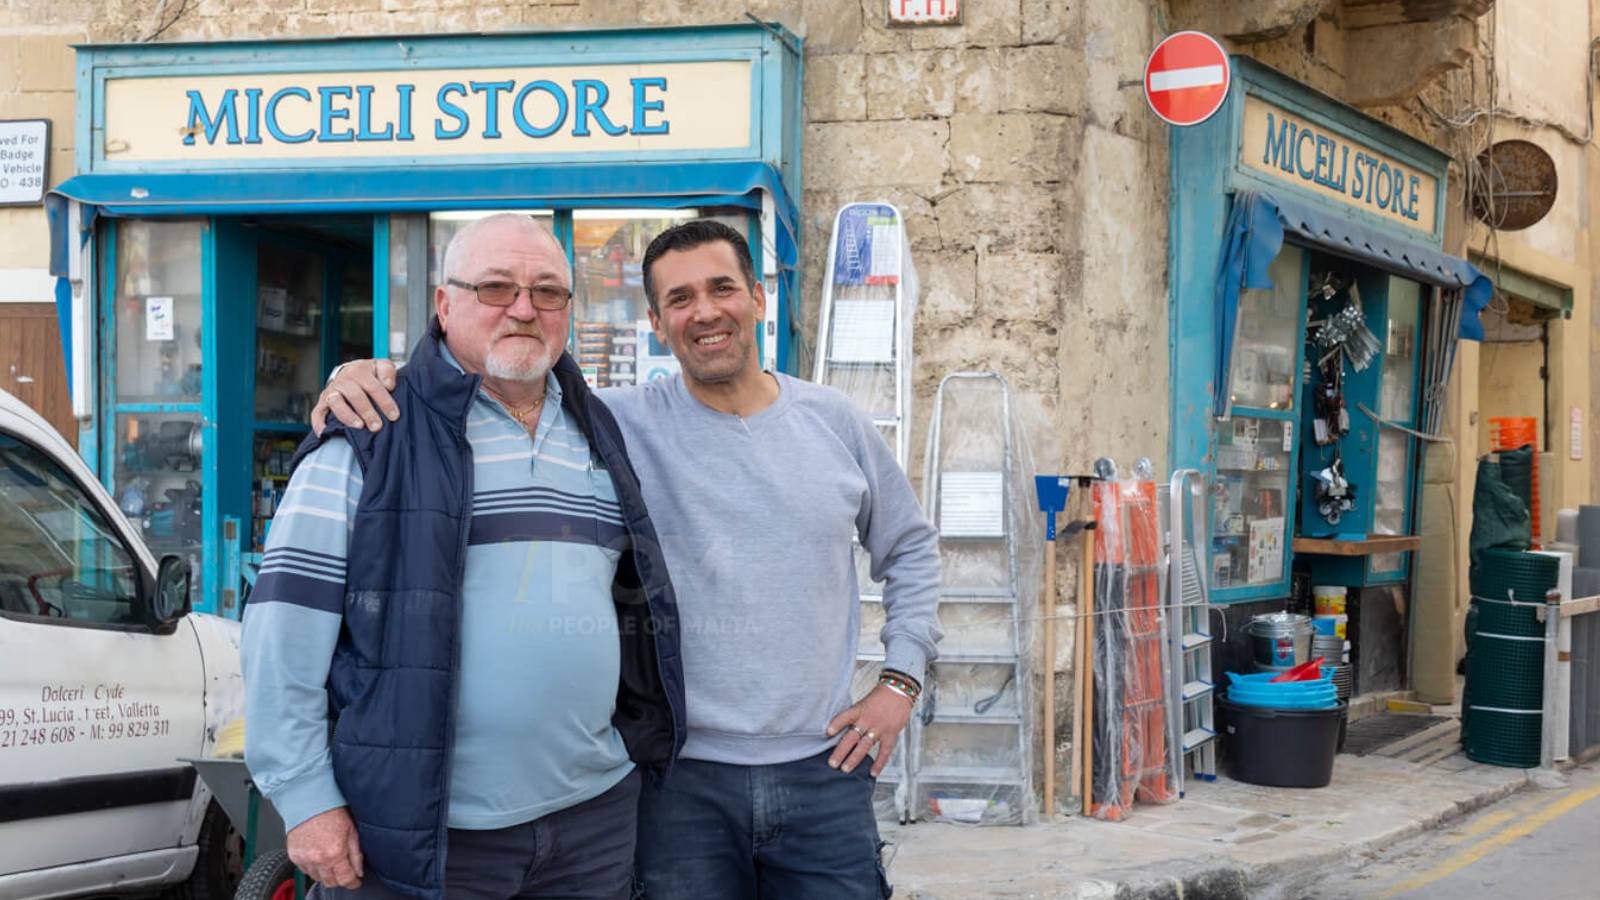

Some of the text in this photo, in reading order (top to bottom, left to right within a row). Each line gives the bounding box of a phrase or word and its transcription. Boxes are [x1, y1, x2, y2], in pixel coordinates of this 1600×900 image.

[183, 77, 670, 146] MICELI STORE
[21, 134, 39, 146] For
[0, 149, 34, 161] Badge
[3, 163, 42, 174] Vehicle
[1263, 112, 1420, 221] MICELI STORE
[19, 177, 42, 188] 438
[42, 706, 74, 723] Lucia
[118, 702, 160, 718] Valletta
[2, 729, 16, 748] 21
[20, 727, 46, 746] 248
[50, 726, 76, 744] 608
[108, 722, 124, 740] 99
[127, 720, 150, 738] 829
[152, 718, 169, 736] 311
